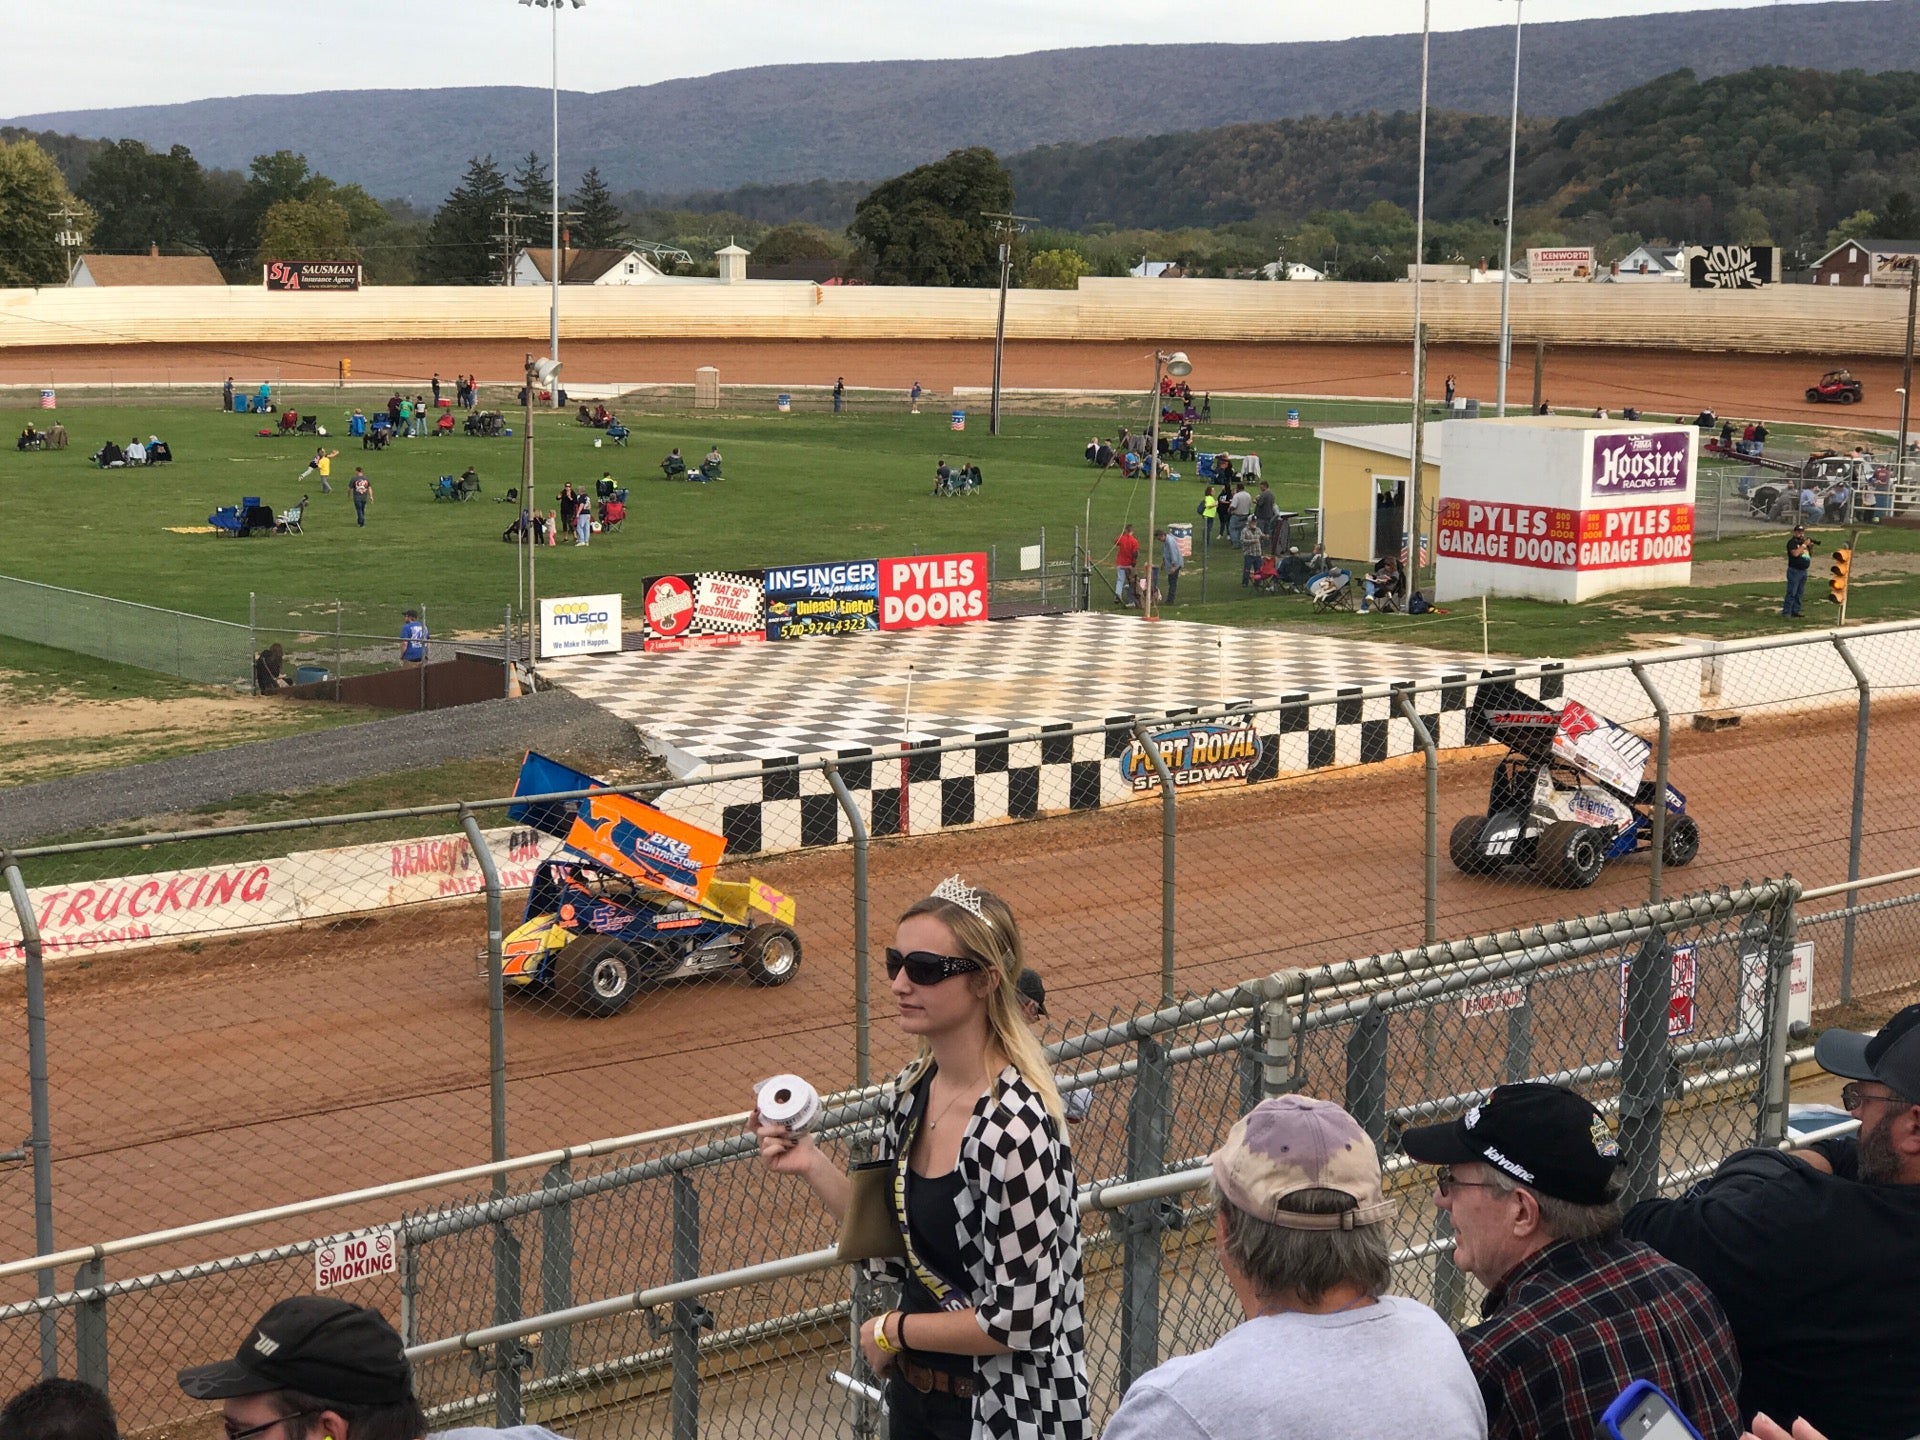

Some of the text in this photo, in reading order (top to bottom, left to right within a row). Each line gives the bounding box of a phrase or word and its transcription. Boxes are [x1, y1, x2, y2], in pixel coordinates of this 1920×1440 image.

[1542, 251, 1589, 260] KENWORTH
[1704, 246, 1751, 272] MOON
[301, 265, 355, 274] SAUSMAN
[333, 276, 356, 285] Agency
[1704, 261, 1762, 288] SHINE
[1596, 441, 1684, 486] Hoosier
[1623, 477, 1677, 488] RACING TIRE
[1442, 519, 1465, 528] DOOR
[1468, 505, 1548, 536] PYLES
[1555, 512, 1571, 520] 800
[1555, 521, 1571, 529] 515
[1605, 509, 1671, 538] PYLES
[1671, 524, 1691, 532] DOOR
[1439, 529, 1577, 565] GARAGE DOORS
[1550, 530, 1575, 539] DOOR
[1583, 531, 1603, 539] DOOR
[1580, 534, 1692, 566] GARAGE DOORS
[769, 563, 876, 590] INSINGER
[892, 559, 975, 591] PYLES
[710, 583, 750, 599] THAT 50'S
[715, 596, 741, 609] STYLE
[810, 582, 876, 597] Performance
[698, 605, 753, 623] RESTAURANT!
[796, 598, 837, 615] Unleash
[884, 589, 983, 623] DOORS
[781, 618, 866, 637] 570-924-4323
[587, 639, 609, 647] Happen
[1191, 729, 1257, 765] ROYAL
[1133, 762, 1252, 791] SPEDWAY
[509, 829, 540, 863] CAR
[636, 837, 703, 872] CONTRACTORS
[649, 831, 692, 857] BRB
[37, 866, 270, 931] TRUCKING
[502, 938, 541, 976] 7
[1483, 1146, 1535, 1182] Valvoline
[344, 1241, 368, 1262] NO
[320, 1253, 392, 1286] SMOKING
